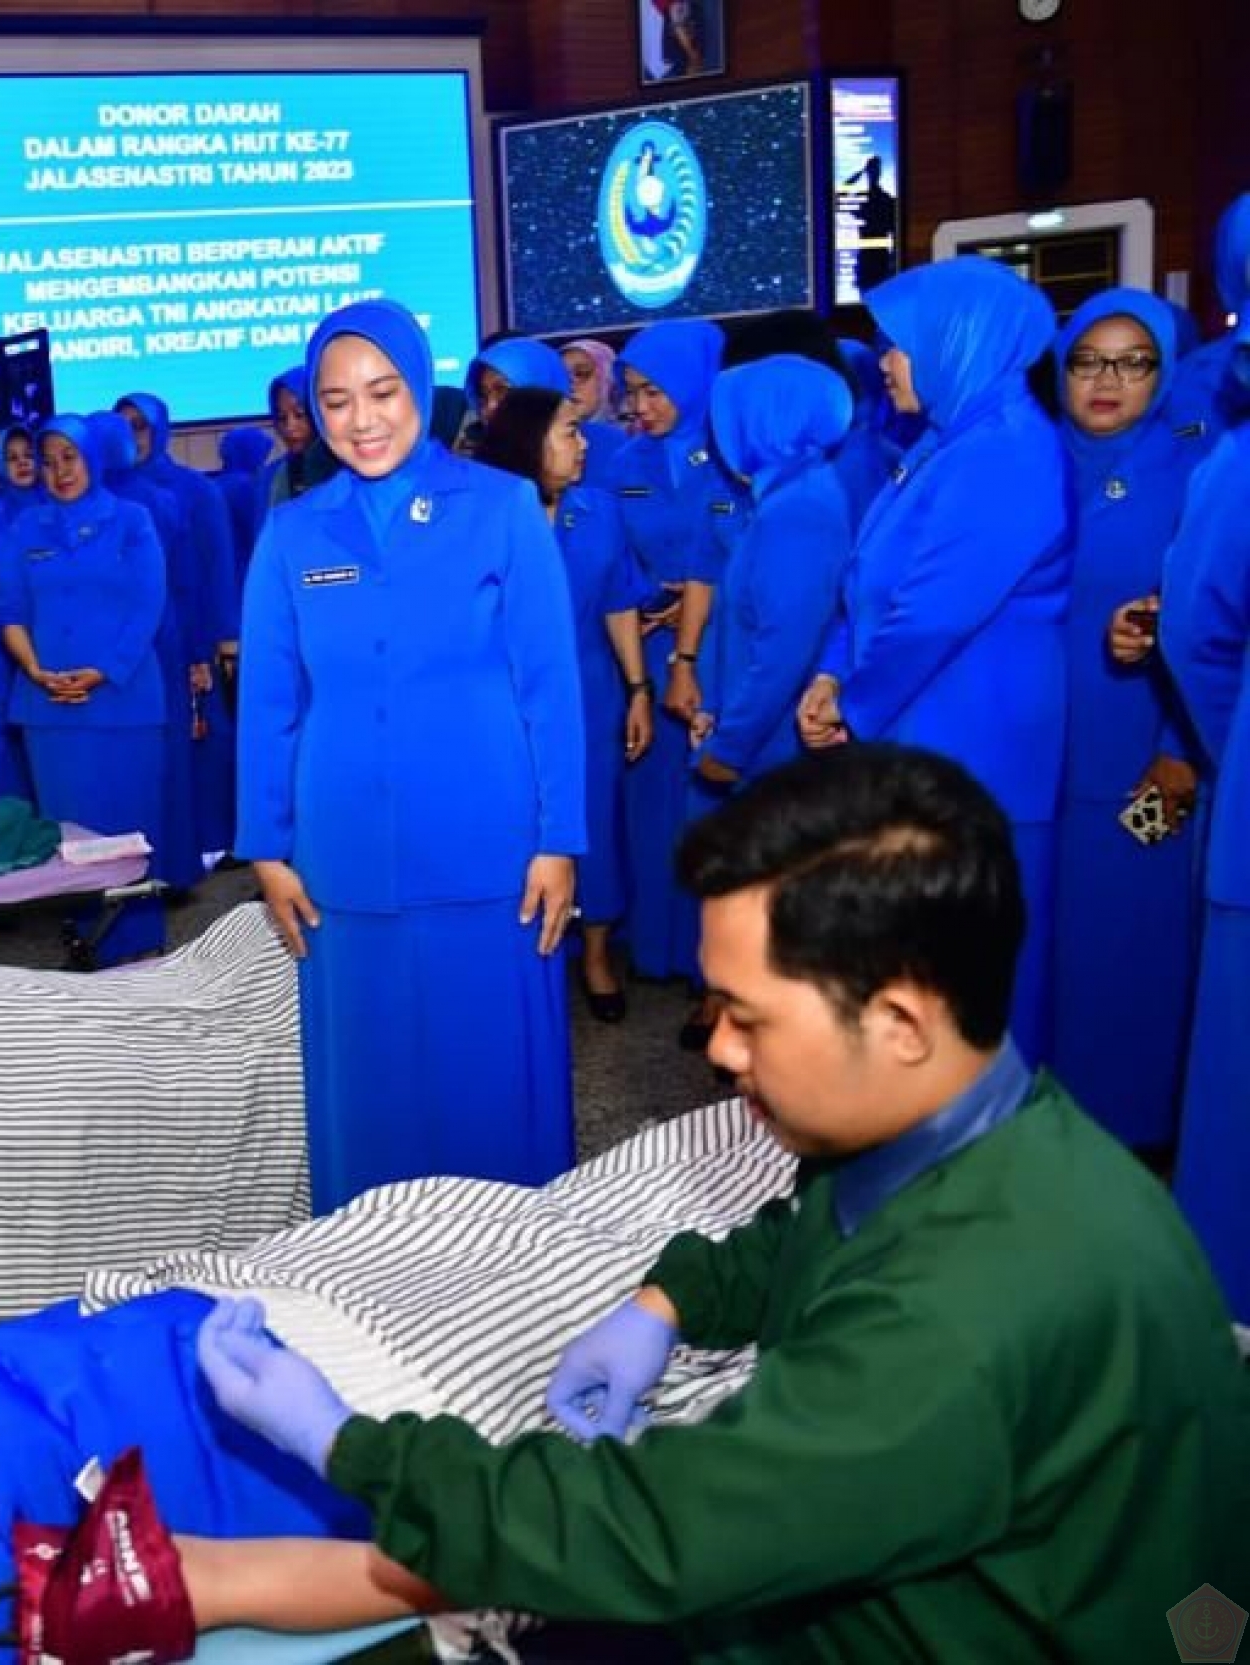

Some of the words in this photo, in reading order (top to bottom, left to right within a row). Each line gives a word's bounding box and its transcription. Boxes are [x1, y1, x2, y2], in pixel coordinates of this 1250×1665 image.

[99, 104, 188, 126] DONOR
[195, 103, 281, 124] DARAH
[24, 136, 116, 160] DALAM
[121, 133, 227, 157] RANGKA
[232, 132, 280, 152] HUT
[285, 130, 350, 152] KE-77
[25, 164, 213, 190] JALASENASTRI
[218, 161, 298, 184] TAHUN
[303, 160, 353, 181] 2023
[187, 237, 315, 263] BERPERAN
[319, 233, 384, 255] AKTIF
[25, 271, 255, 302] MENGEMBANGKAN
[261, 263, 361, 288] POTENSI
[3, 306, 143, 335] KELUARGA
[149, 303, 188, 323] TNI
[193, 294, 320, 322] ANGKATAN
[145, 327, 245, 354] KREATIF
[250, 324, 301, 346] DAN
